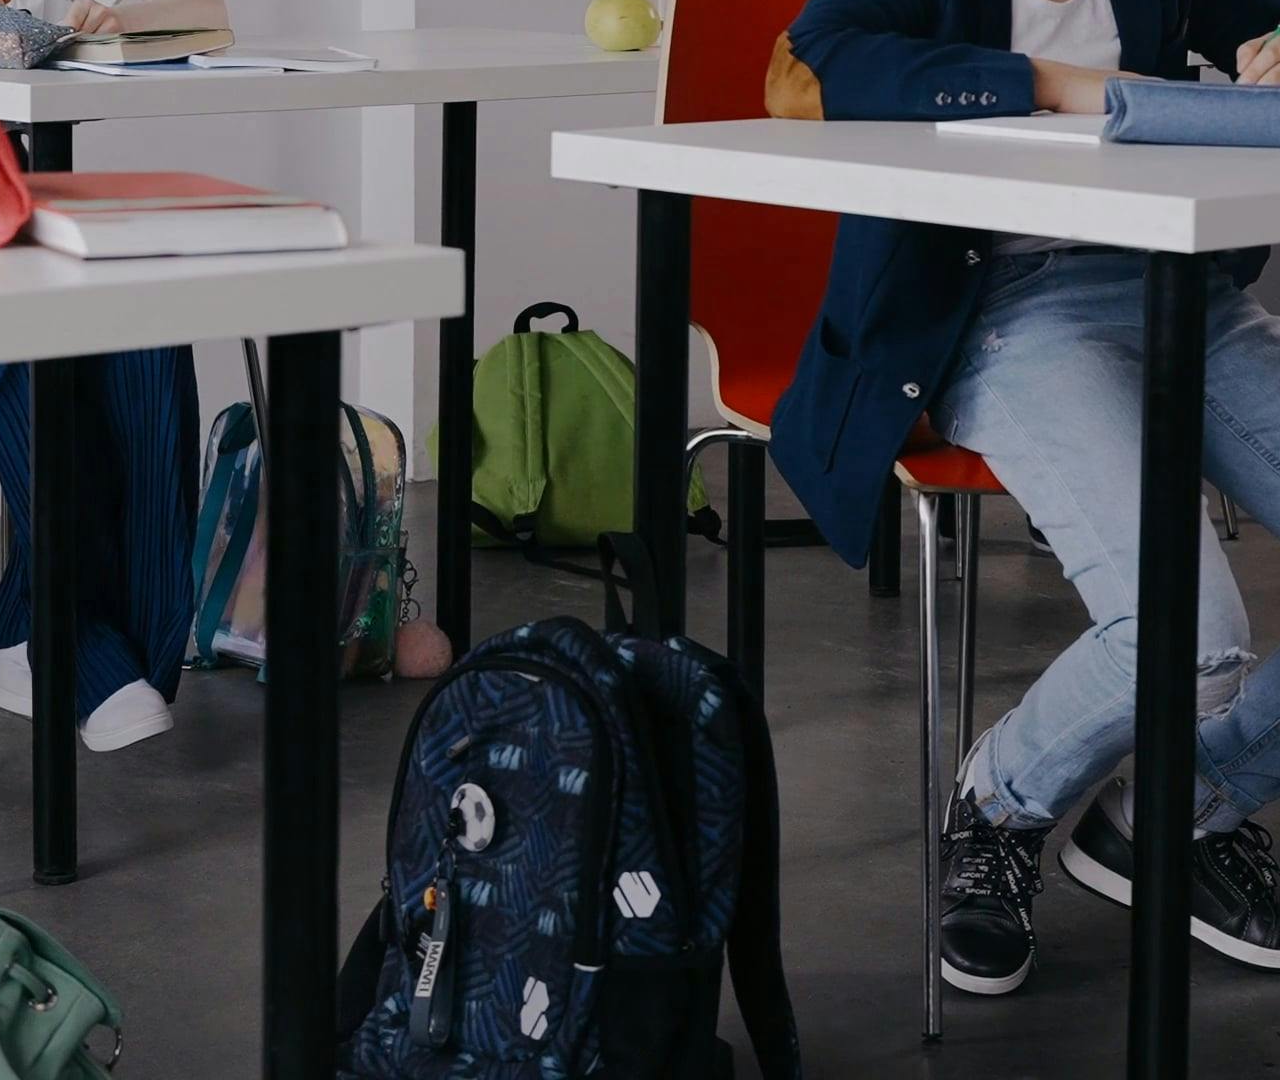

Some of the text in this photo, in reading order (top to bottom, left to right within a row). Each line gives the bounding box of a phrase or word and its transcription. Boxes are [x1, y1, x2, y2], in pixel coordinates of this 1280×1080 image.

[959, 871, 986, 879] SPORT
[1006, 870, 1018, 894] SPORT
[964, 887, 992, 896] SPORT
[1019, 907, 1031, 931] SPORT
